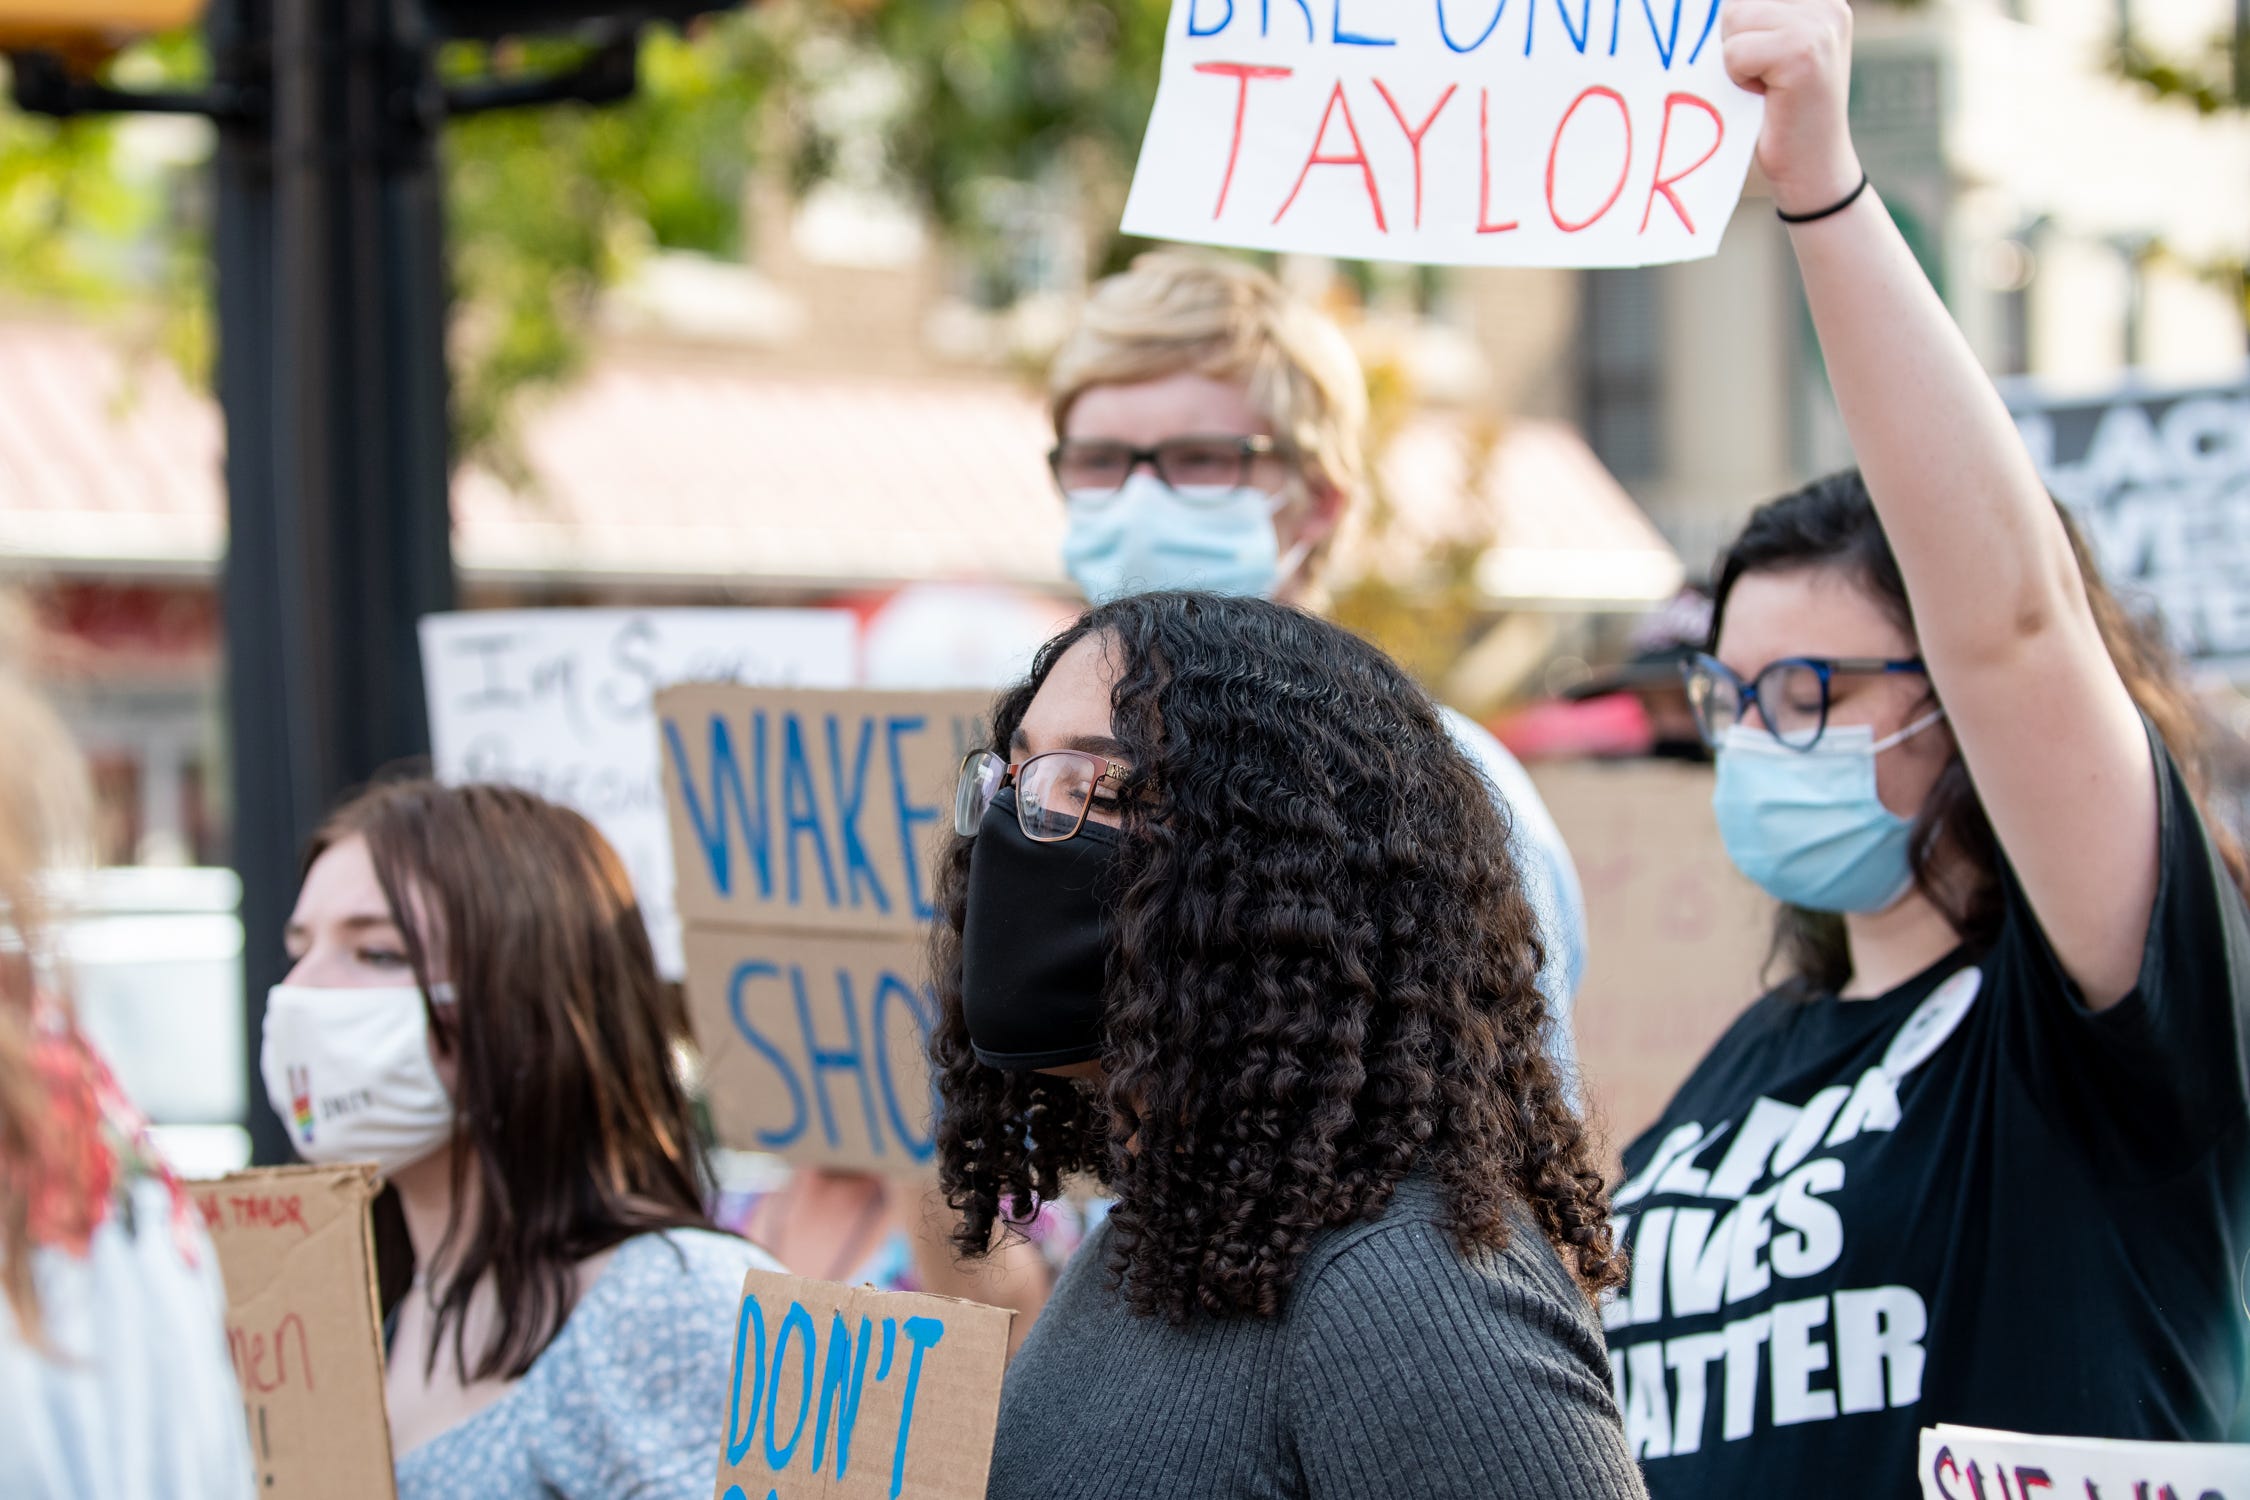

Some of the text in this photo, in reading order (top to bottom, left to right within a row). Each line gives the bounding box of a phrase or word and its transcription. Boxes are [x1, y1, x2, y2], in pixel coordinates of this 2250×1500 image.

[1192, 62, 1724, 235] TAYLOR
[662, 708, 943, 922] WAKE
[726, 1293, 944, 1500] DON'T
